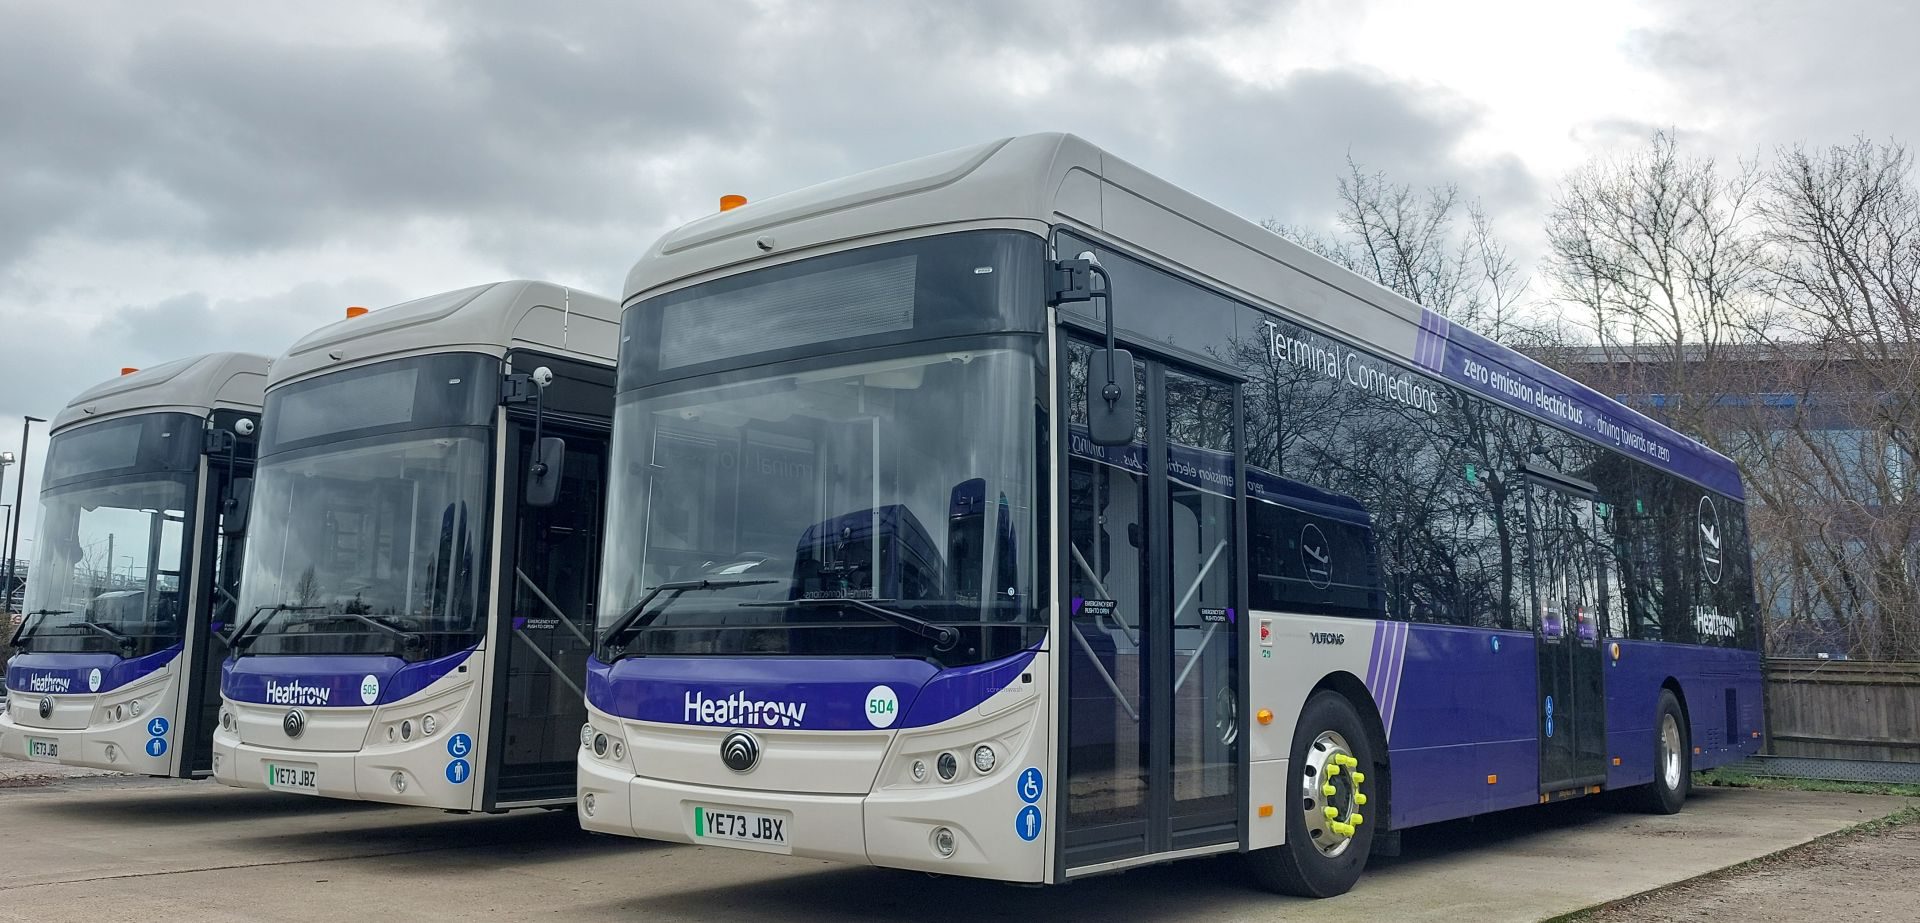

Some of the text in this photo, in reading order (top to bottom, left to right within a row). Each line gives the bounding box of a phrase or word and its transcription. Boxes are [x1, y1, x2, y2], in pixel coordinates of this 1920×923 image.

[1264, 320, 1438, 414] Terminal Connections
[1463, 359, 1488, 384] zero
[1490, 372, 1533, 404] emission
[1535, 386, 1567, 419] electric
[1568, 399, 1583, 425] bus
[1597, 413, 1620, 446] driving
[1621, 426, 1646, 453] towards
[1646, 440, 1657, 457] net
[1657, 445, 1670, 462] zero
[1696, 605, 1736, 638] Heathrow
[1310, 632, 1345, 646] YUTONG
[30, 672, 71, 693] Heathrow
[266, 679, 330, 705] Heathrow
[362, 684, 377, 695] 505
[684, 690, 807, 727] Heathrow
[869, 699, 894, 714] 504
[32, 742, 46, 755] YE73
[275, 767, 316, 787] YE73 JBZ
[705, 811, 784, 842] YE73 JBX
